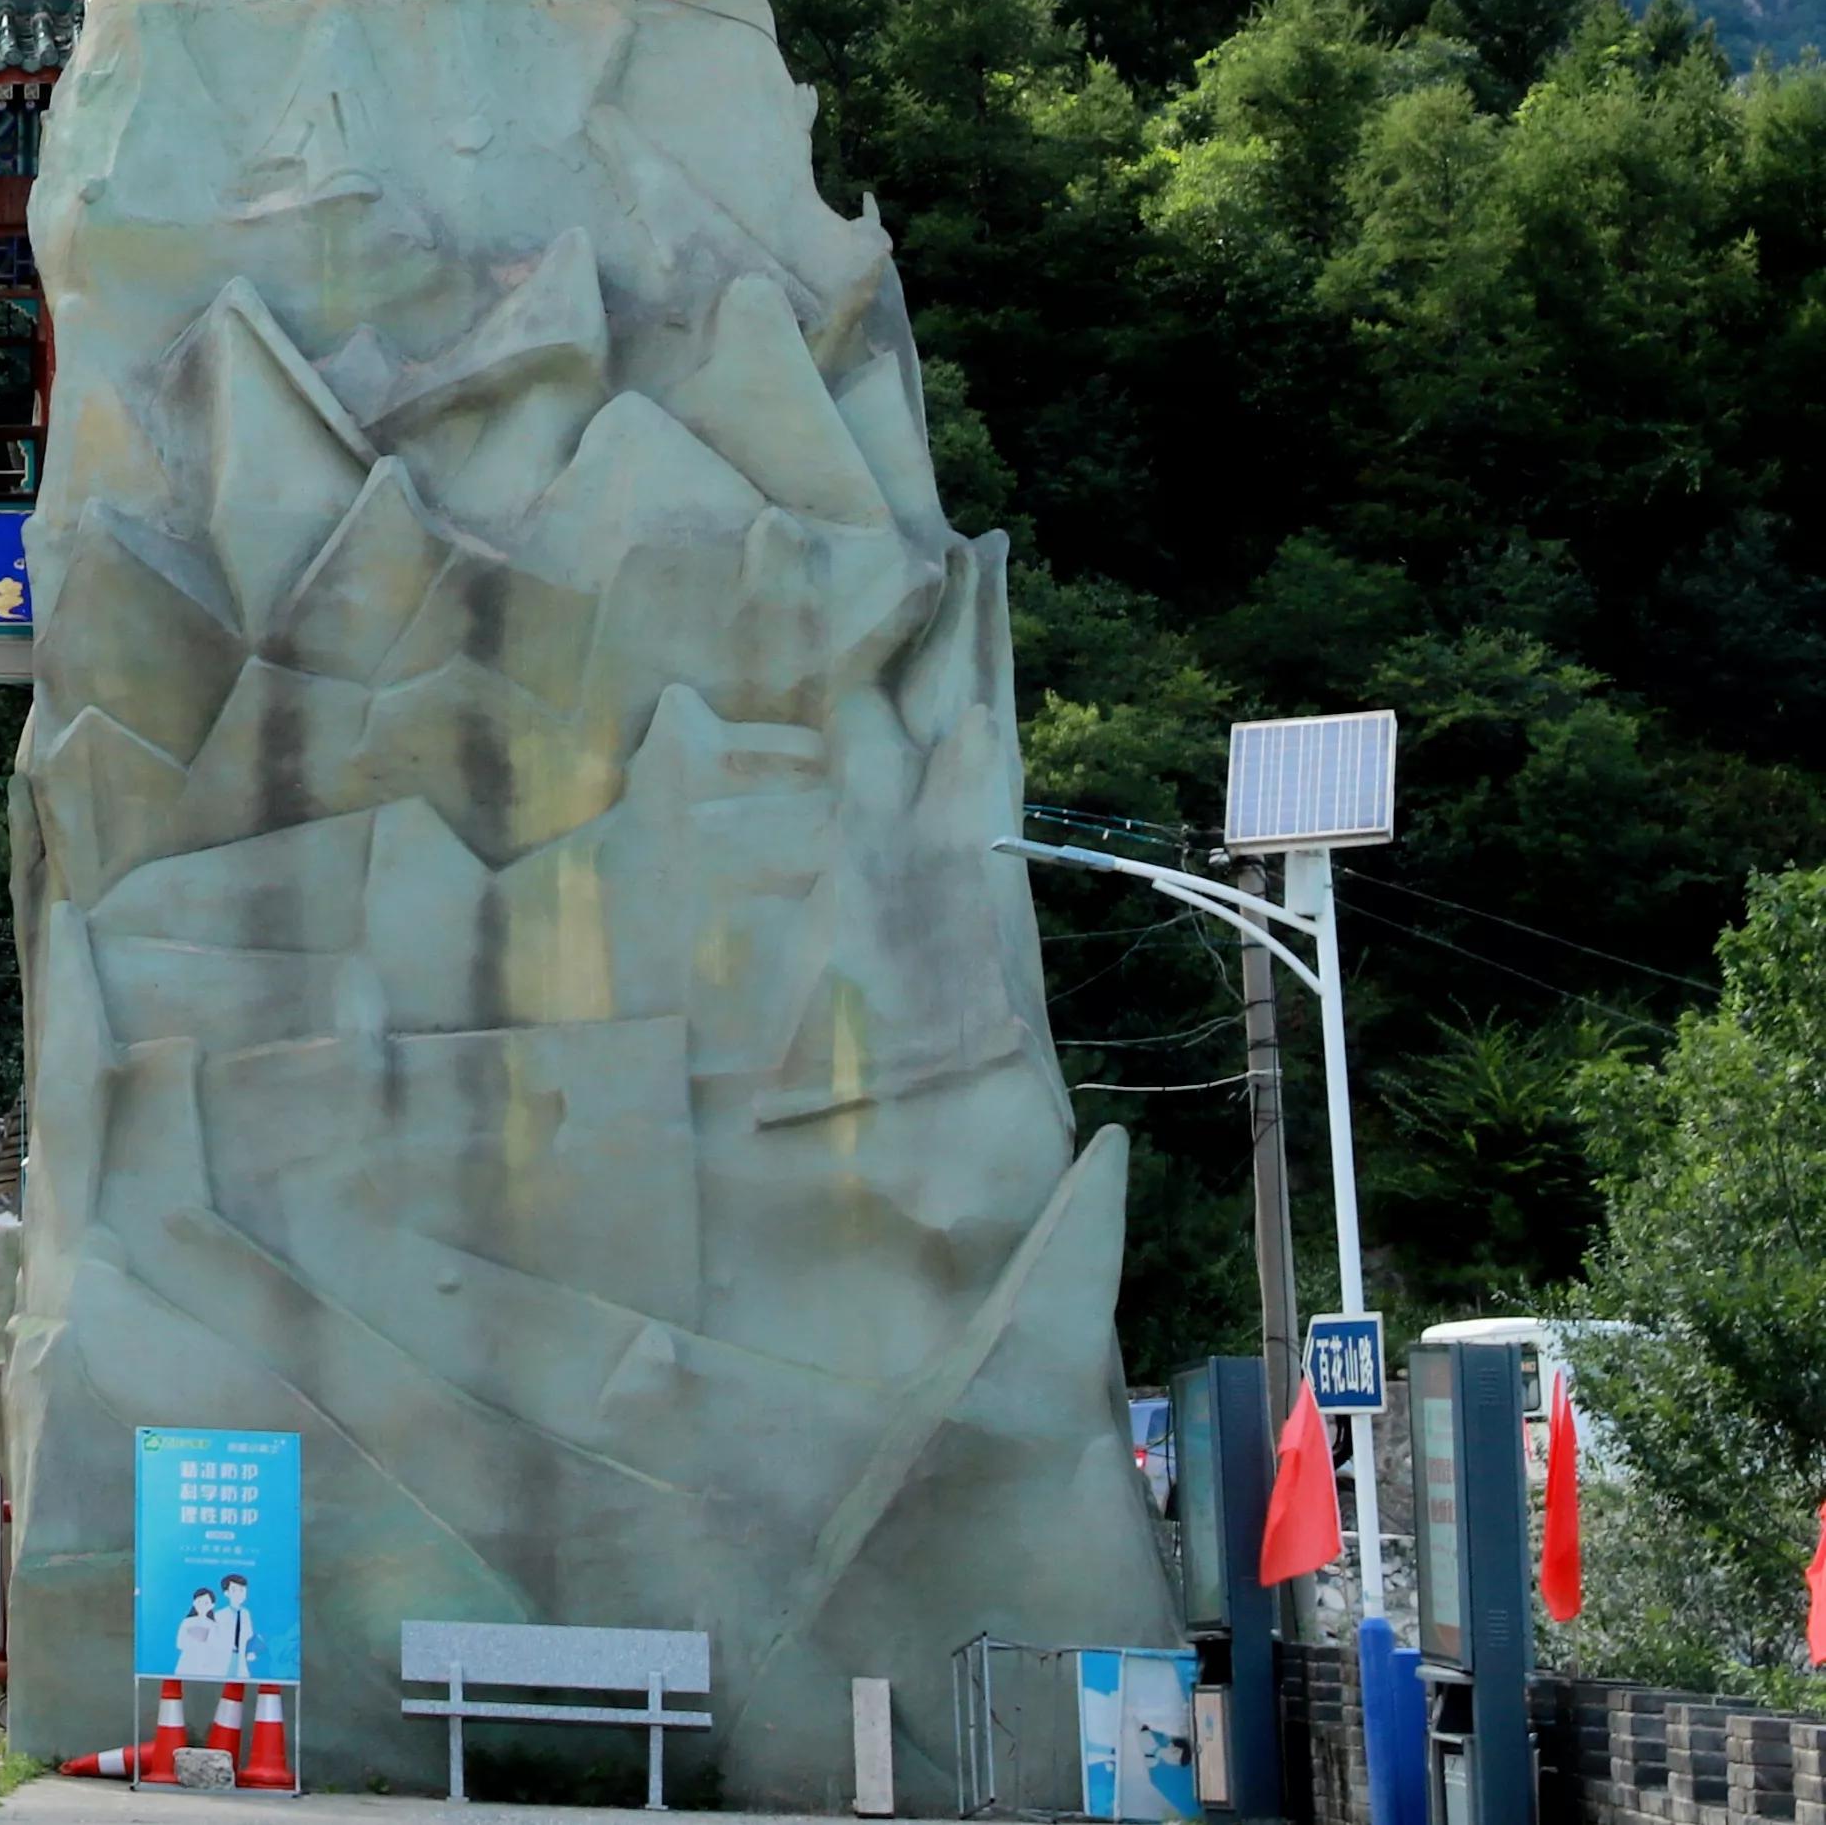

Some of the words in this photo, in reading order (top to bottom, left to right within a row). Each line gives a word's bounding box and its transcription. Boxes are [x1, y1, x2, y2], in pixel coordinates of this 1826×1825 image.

[1315, 1334, 1375, 1395] 百花山路
[180, 1483, 259, 1502] 科学防护
